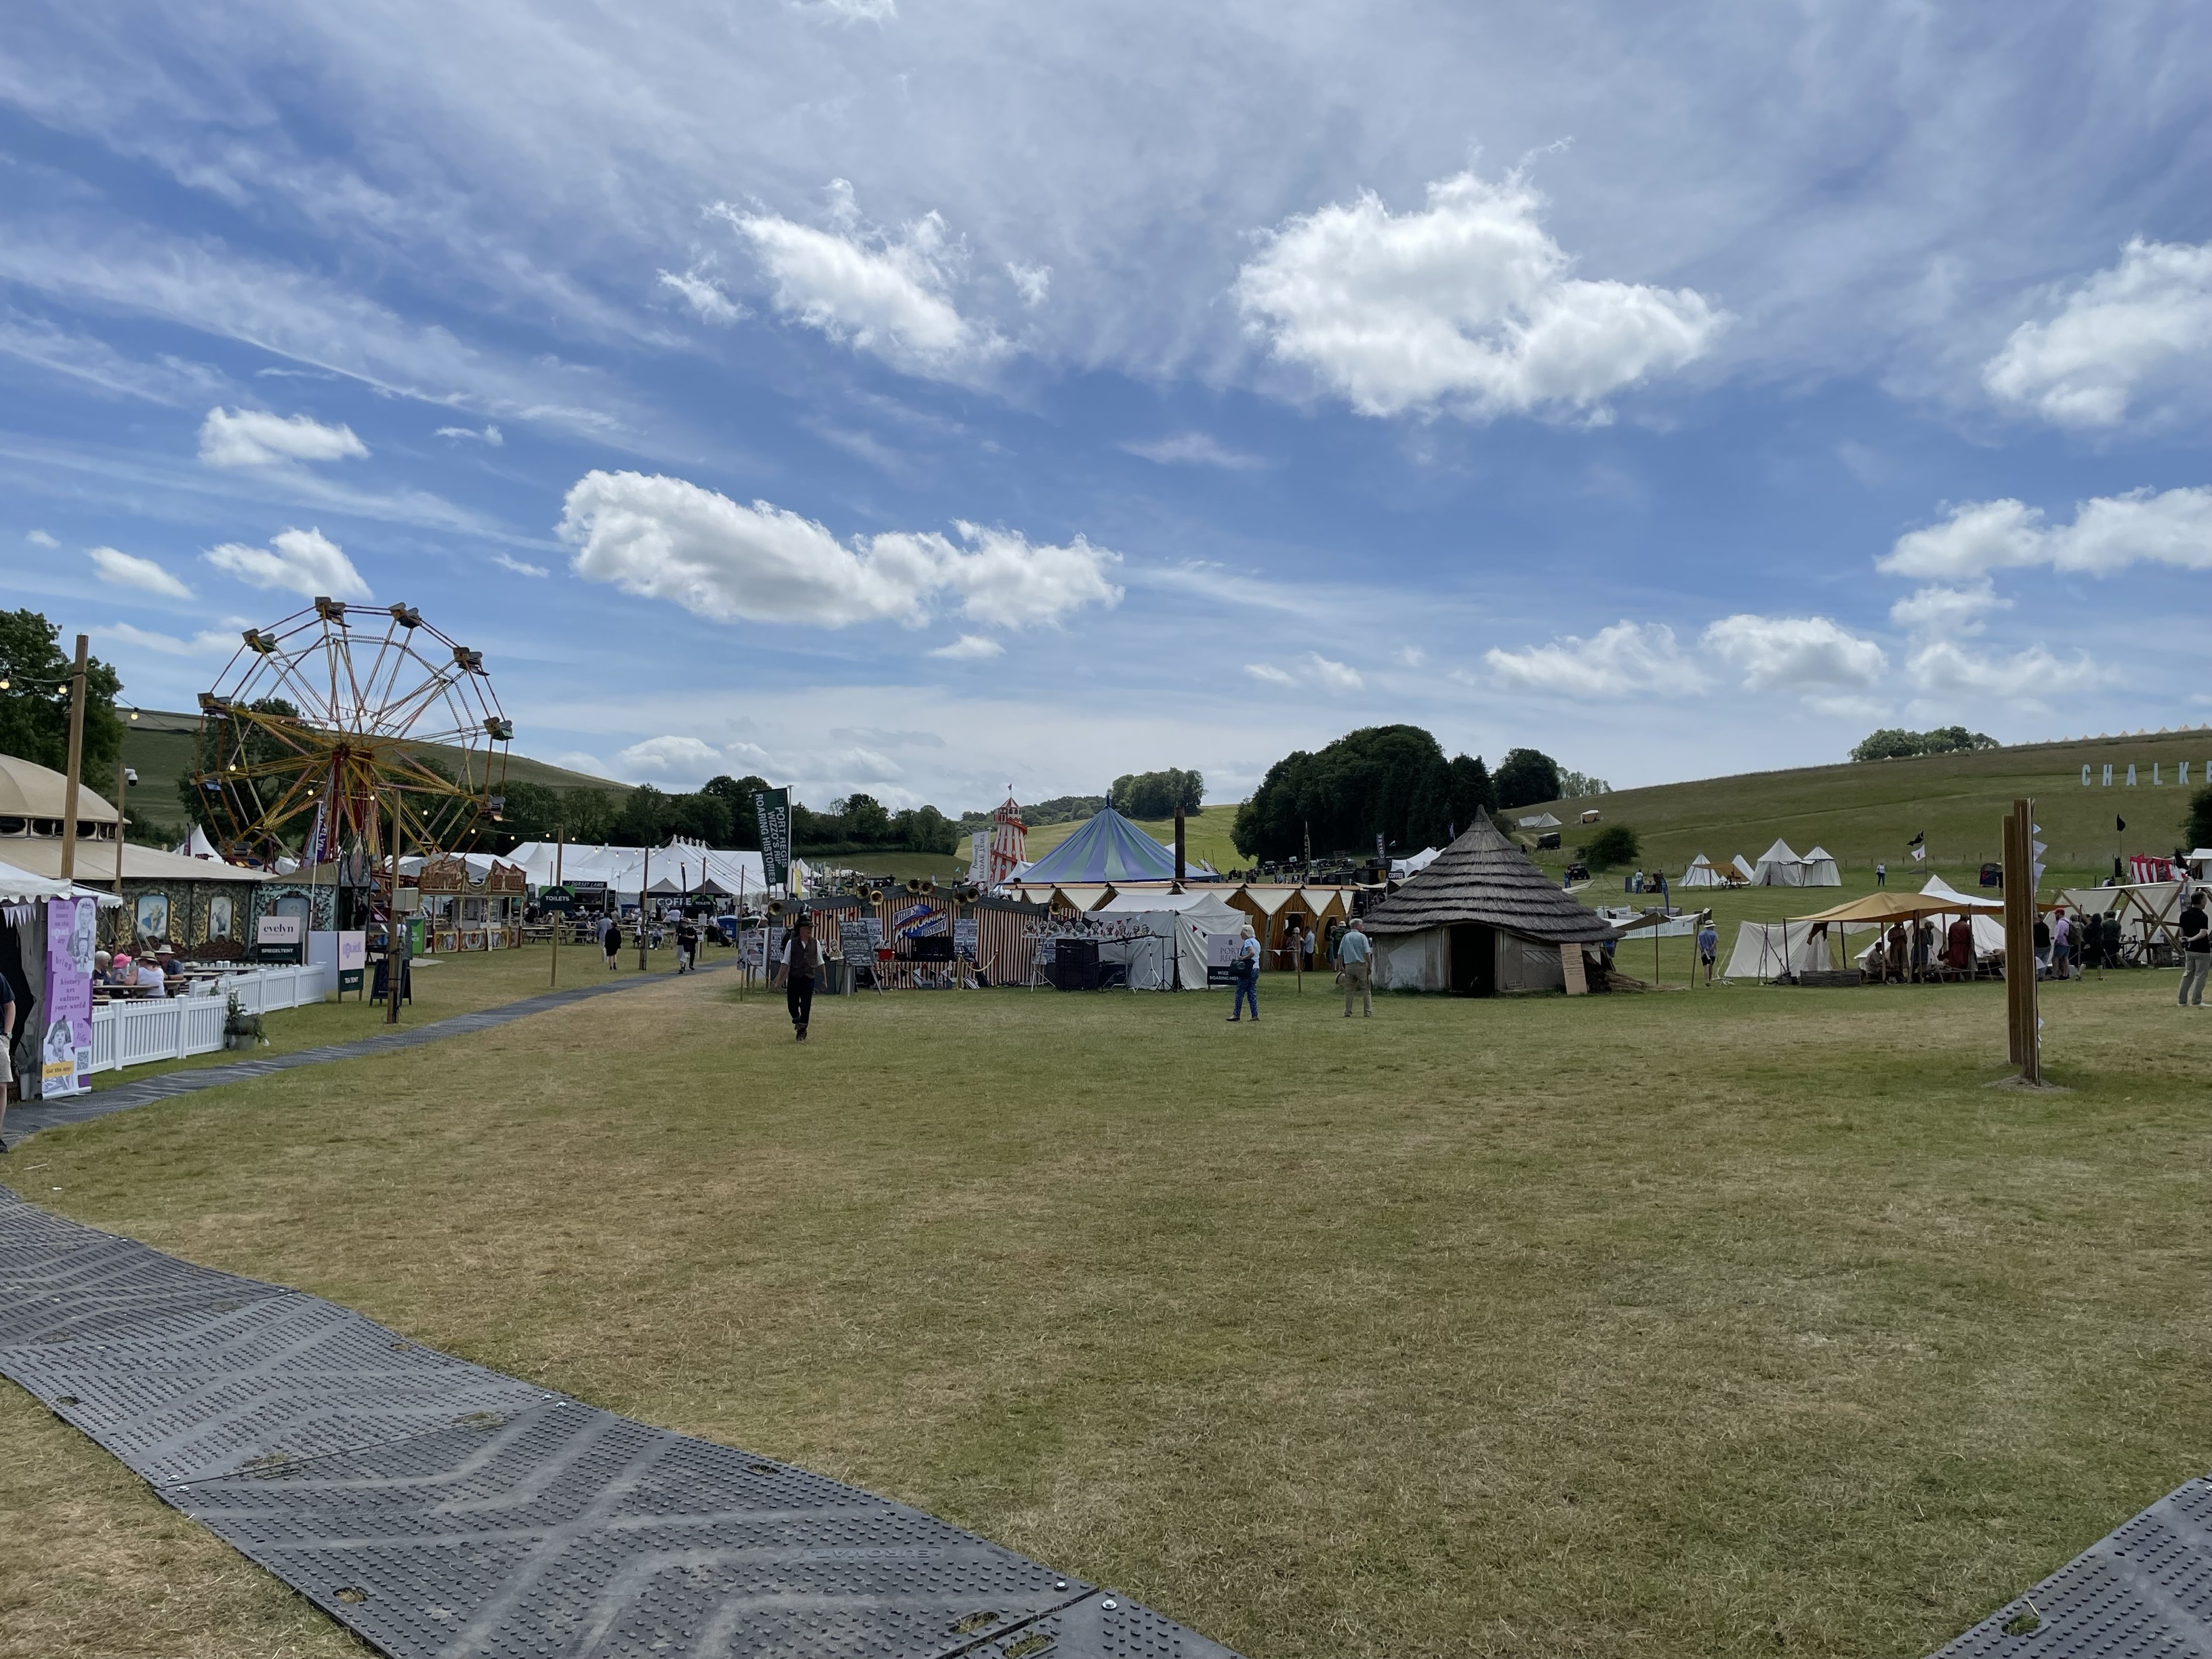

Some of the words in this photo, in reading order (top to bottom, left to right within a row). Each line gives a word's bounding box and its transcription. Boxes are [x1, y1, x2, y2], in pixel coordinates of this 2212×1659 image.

[775, 806, 786, 834] PORT
[755, 794, 769, 835] ROARING
[762, 837, 776, 883] HISTORIES
[767, 811, 779, 847] WIZZO'S
[773, 851, 781, 865] RIP
[779, 837, 787, 868] REGIS
[657, 897, 692, 906] COFFE
[895, 908, 916, 924] WIZZO'S
[264, 924, 293, 936] evelyn
[922, 919, 946, 936] HISTORY
[56, 956, 73, 971] bring
[60, 979, 80, 987] history
[55, 1004, 67, 1012] your
[70, 1002, 86, 1010] world
[77, 1031, 87, 1043] life
